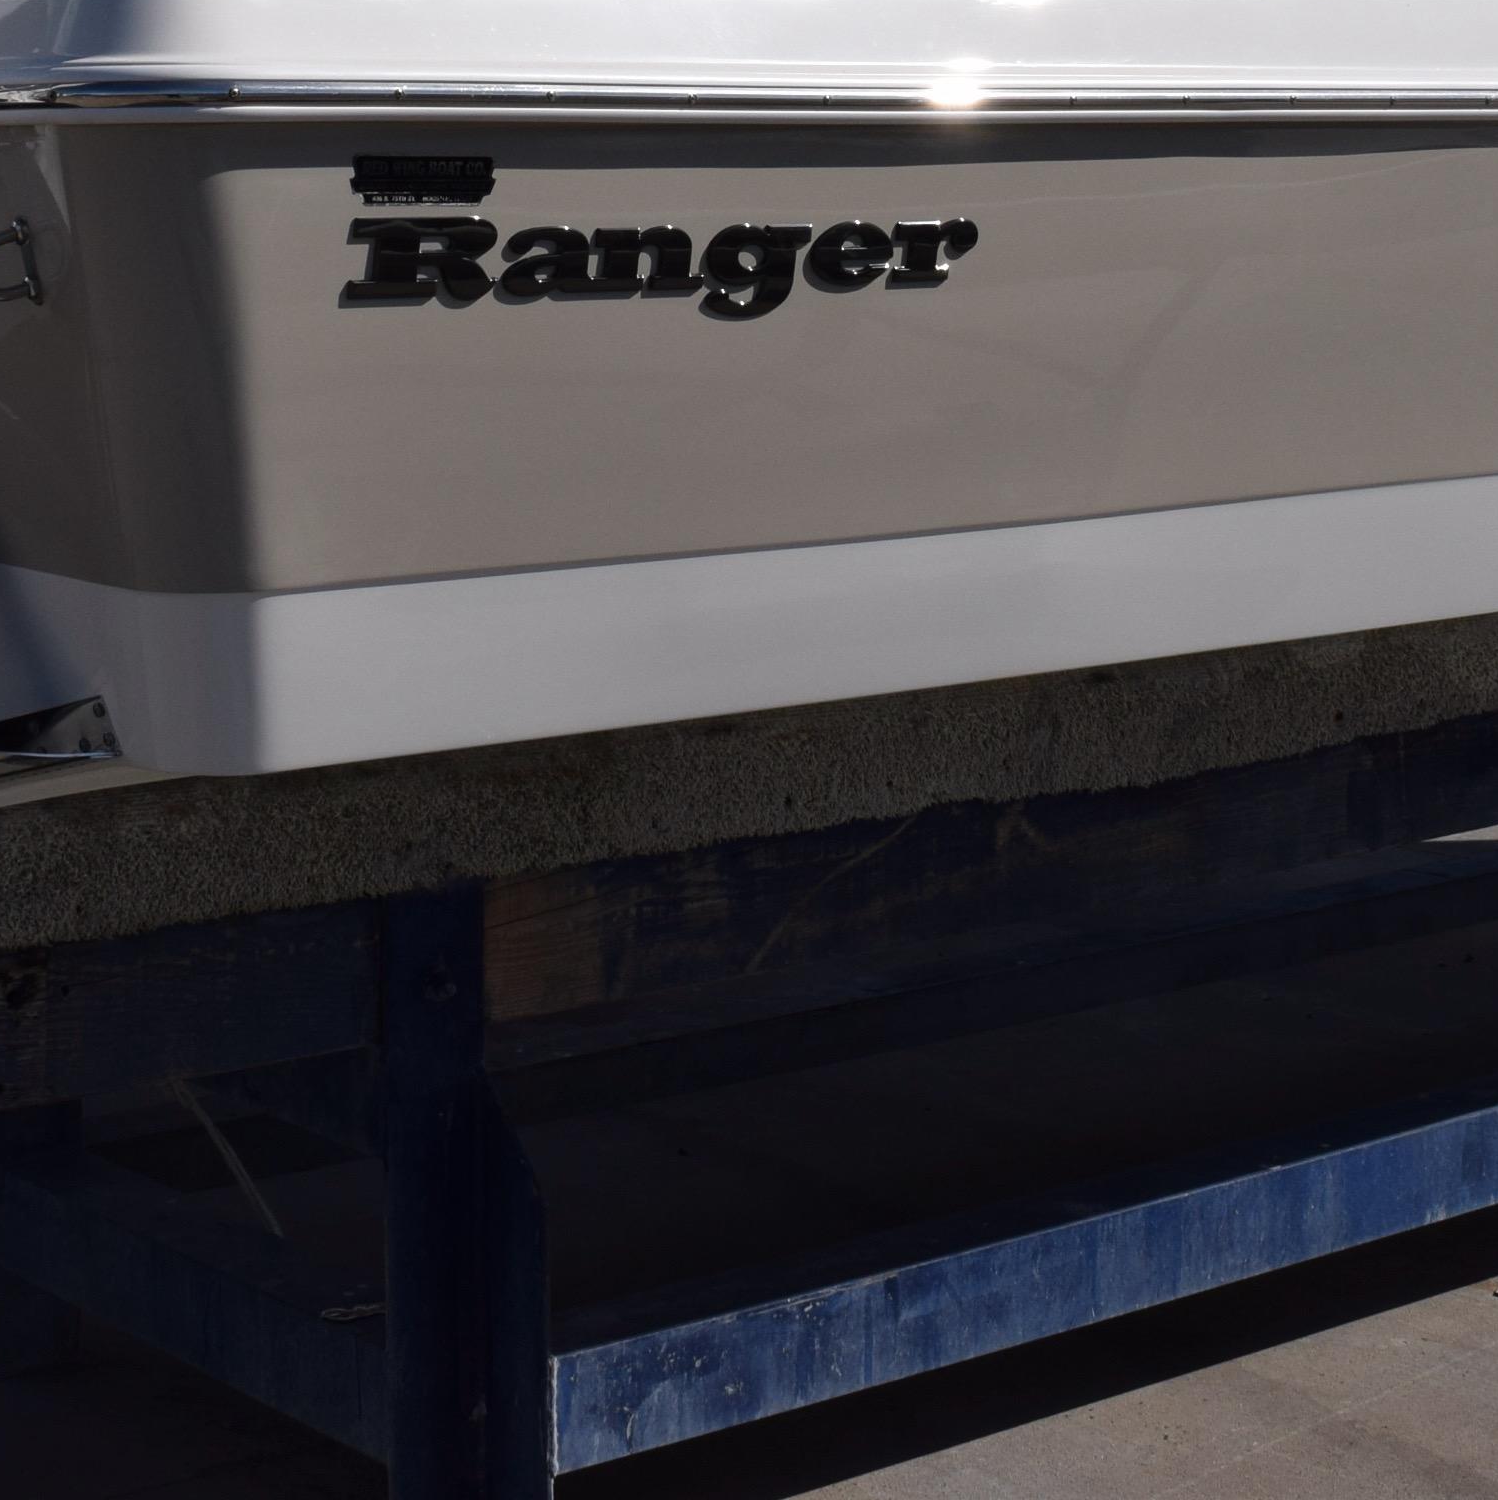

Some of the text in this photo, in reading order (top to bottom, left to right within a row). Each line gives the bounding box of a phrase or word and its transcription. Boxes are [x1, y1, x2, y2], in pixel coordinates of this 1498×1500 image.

[361, 160, 389, 176] RED
[428, 160, 463, 177] BOAT
[343, 214, 979, 319] Ranger
